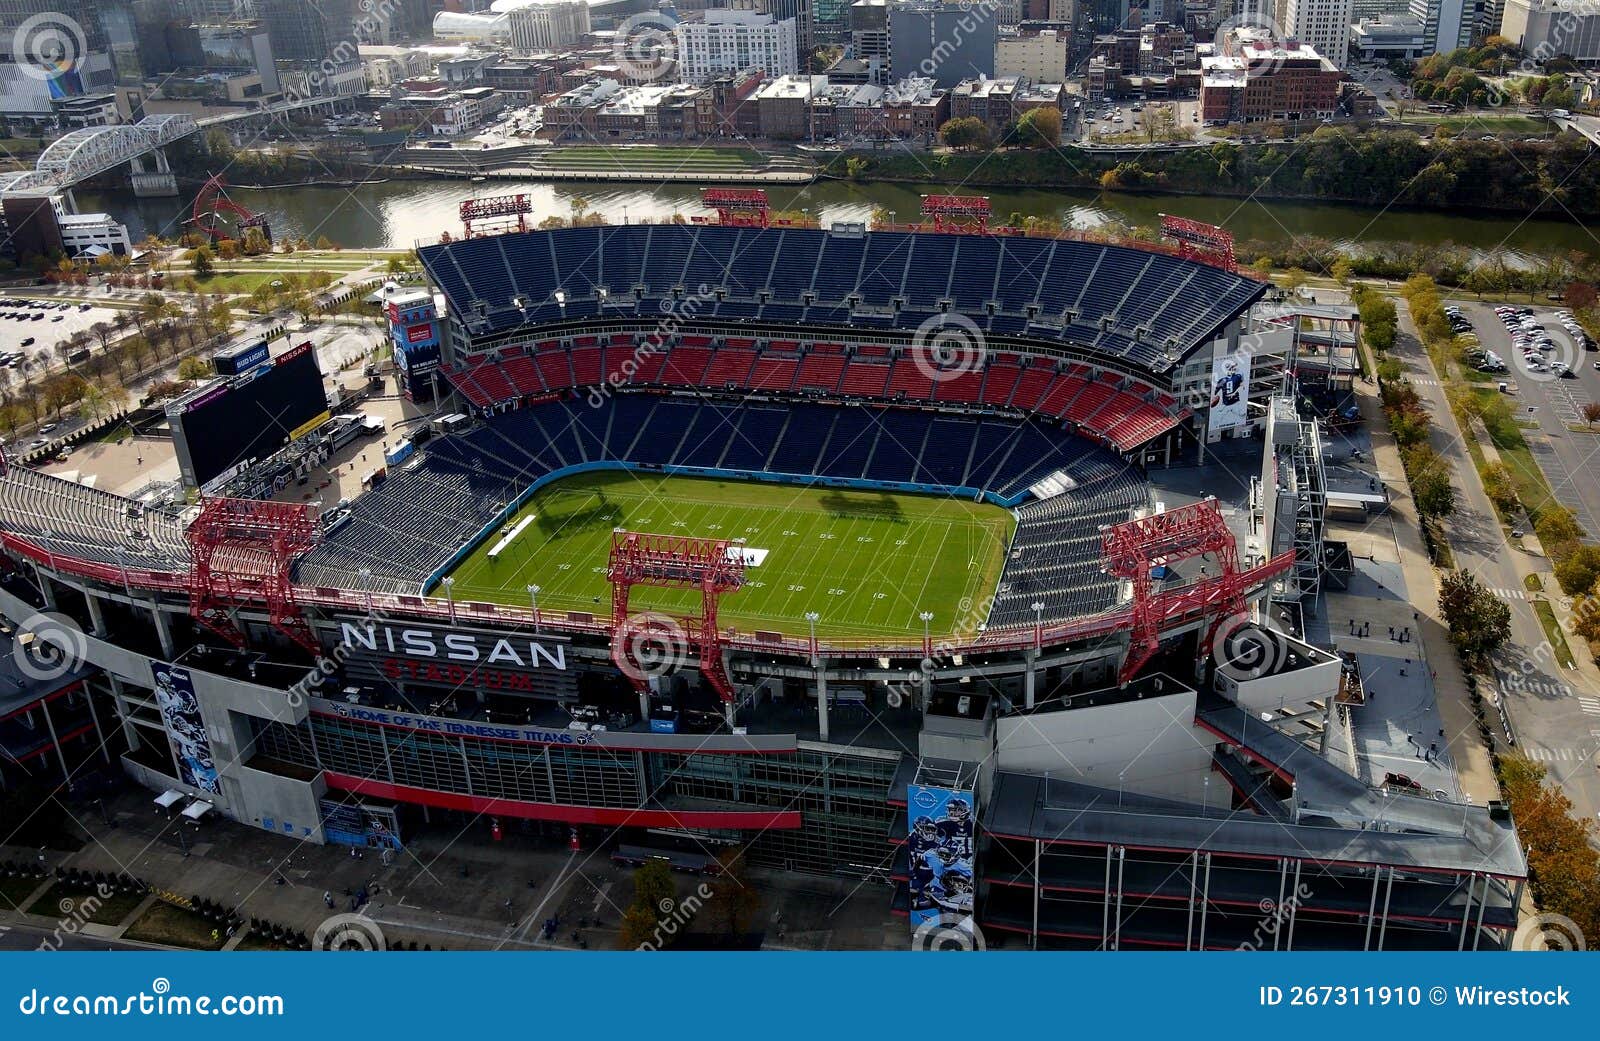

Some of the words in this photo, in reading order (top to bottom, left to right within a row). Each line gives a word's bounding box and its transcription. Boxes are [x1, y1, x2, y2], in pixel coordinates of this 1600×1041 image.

[236, 356, 250, 369] BUD
[249, 349, 266, 365] LIGHT
[280, 345, 307, 363] NISSAN
[1226, 381, 1233, 394] 9
[341, 622, 567, 671] NISSAN
[383, 658, 533, 691] STADIUM
[351, 708, 390, 725] HOME
[393, 715, 412, 728] OF
[416, 718, 441, 731] THE
[444, 722, 520, 741] TENNESSEE
[524, 730, 573, 745] TITANS
